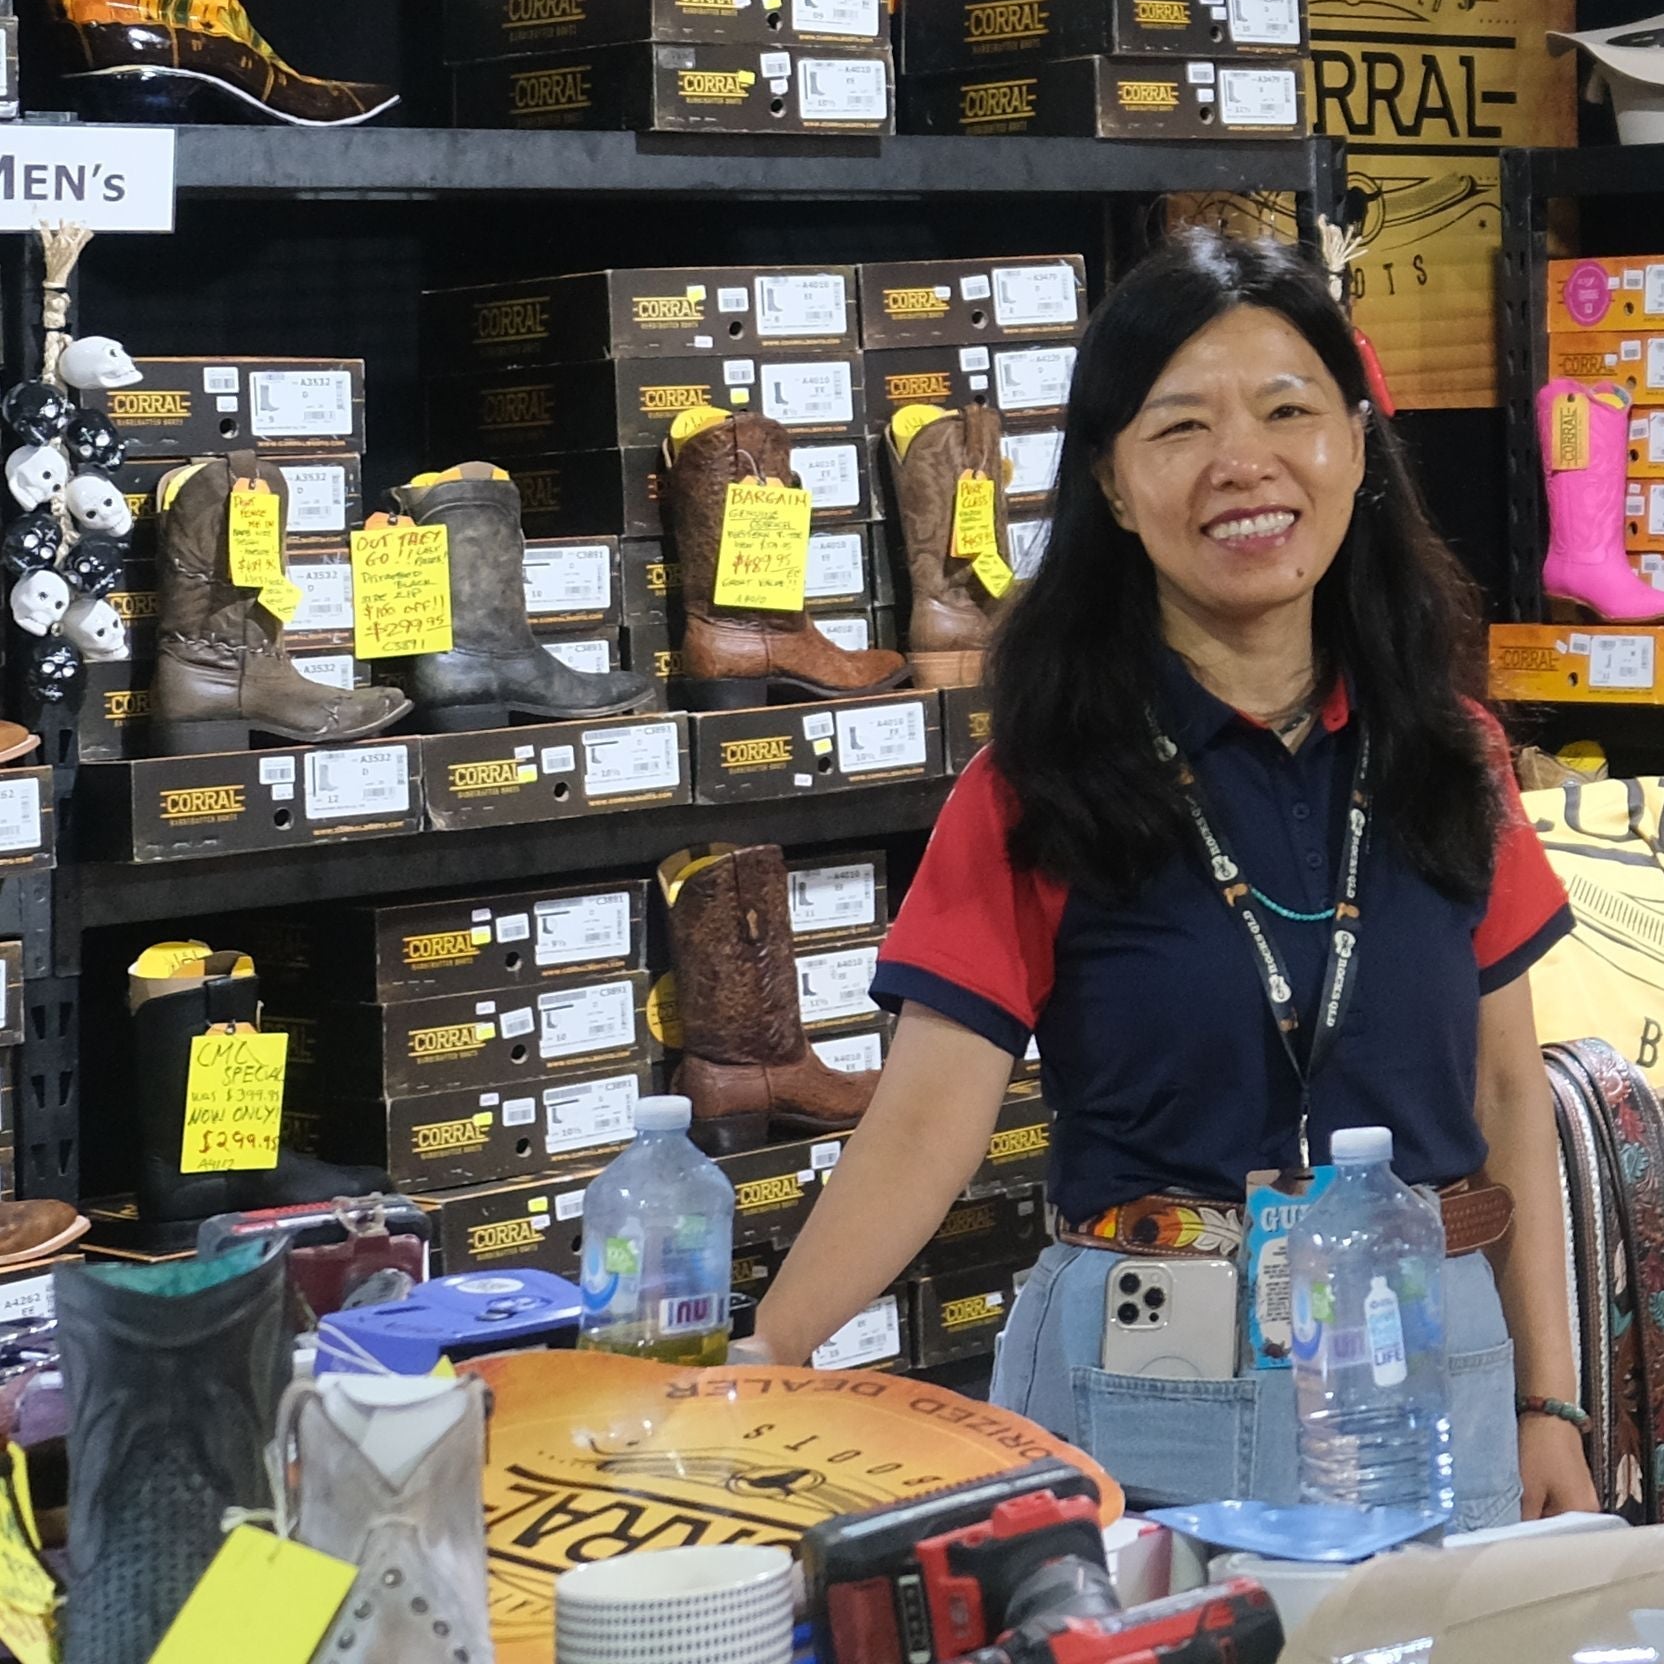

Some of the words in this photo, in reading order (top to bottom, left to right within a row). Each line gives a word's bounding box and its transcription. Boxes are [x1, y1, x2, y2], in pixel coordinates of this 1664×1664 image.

[970, 7, 1043, 35] CORRAL
[1139, 4, 1187, 21] CORRAL
[514, 70, 587, 108] CORRAL
[1123, 87, 1175, 102] CORRAL
[966, 90, 1031, 117] CORRAL
[638, 302, 700, 317] CORRAL
[891, 376, 947, 394] CORRAL
[113, 395, 185, 413] CORRAL
[645, 390, 708, 407] CORRAL
[1564, 408, 1578, 462] CORRAL
[731, 488, 808, 507] BARGAIN
[1503, 651, 1555, 669] CORRAL
[725, 742, 788, 763] CORRAL
[166, 793, 238, 812] CORRAL
[991, 1133, 1046, 1154] CORRAL
[665, 1378, 888, 1401] DEALER
